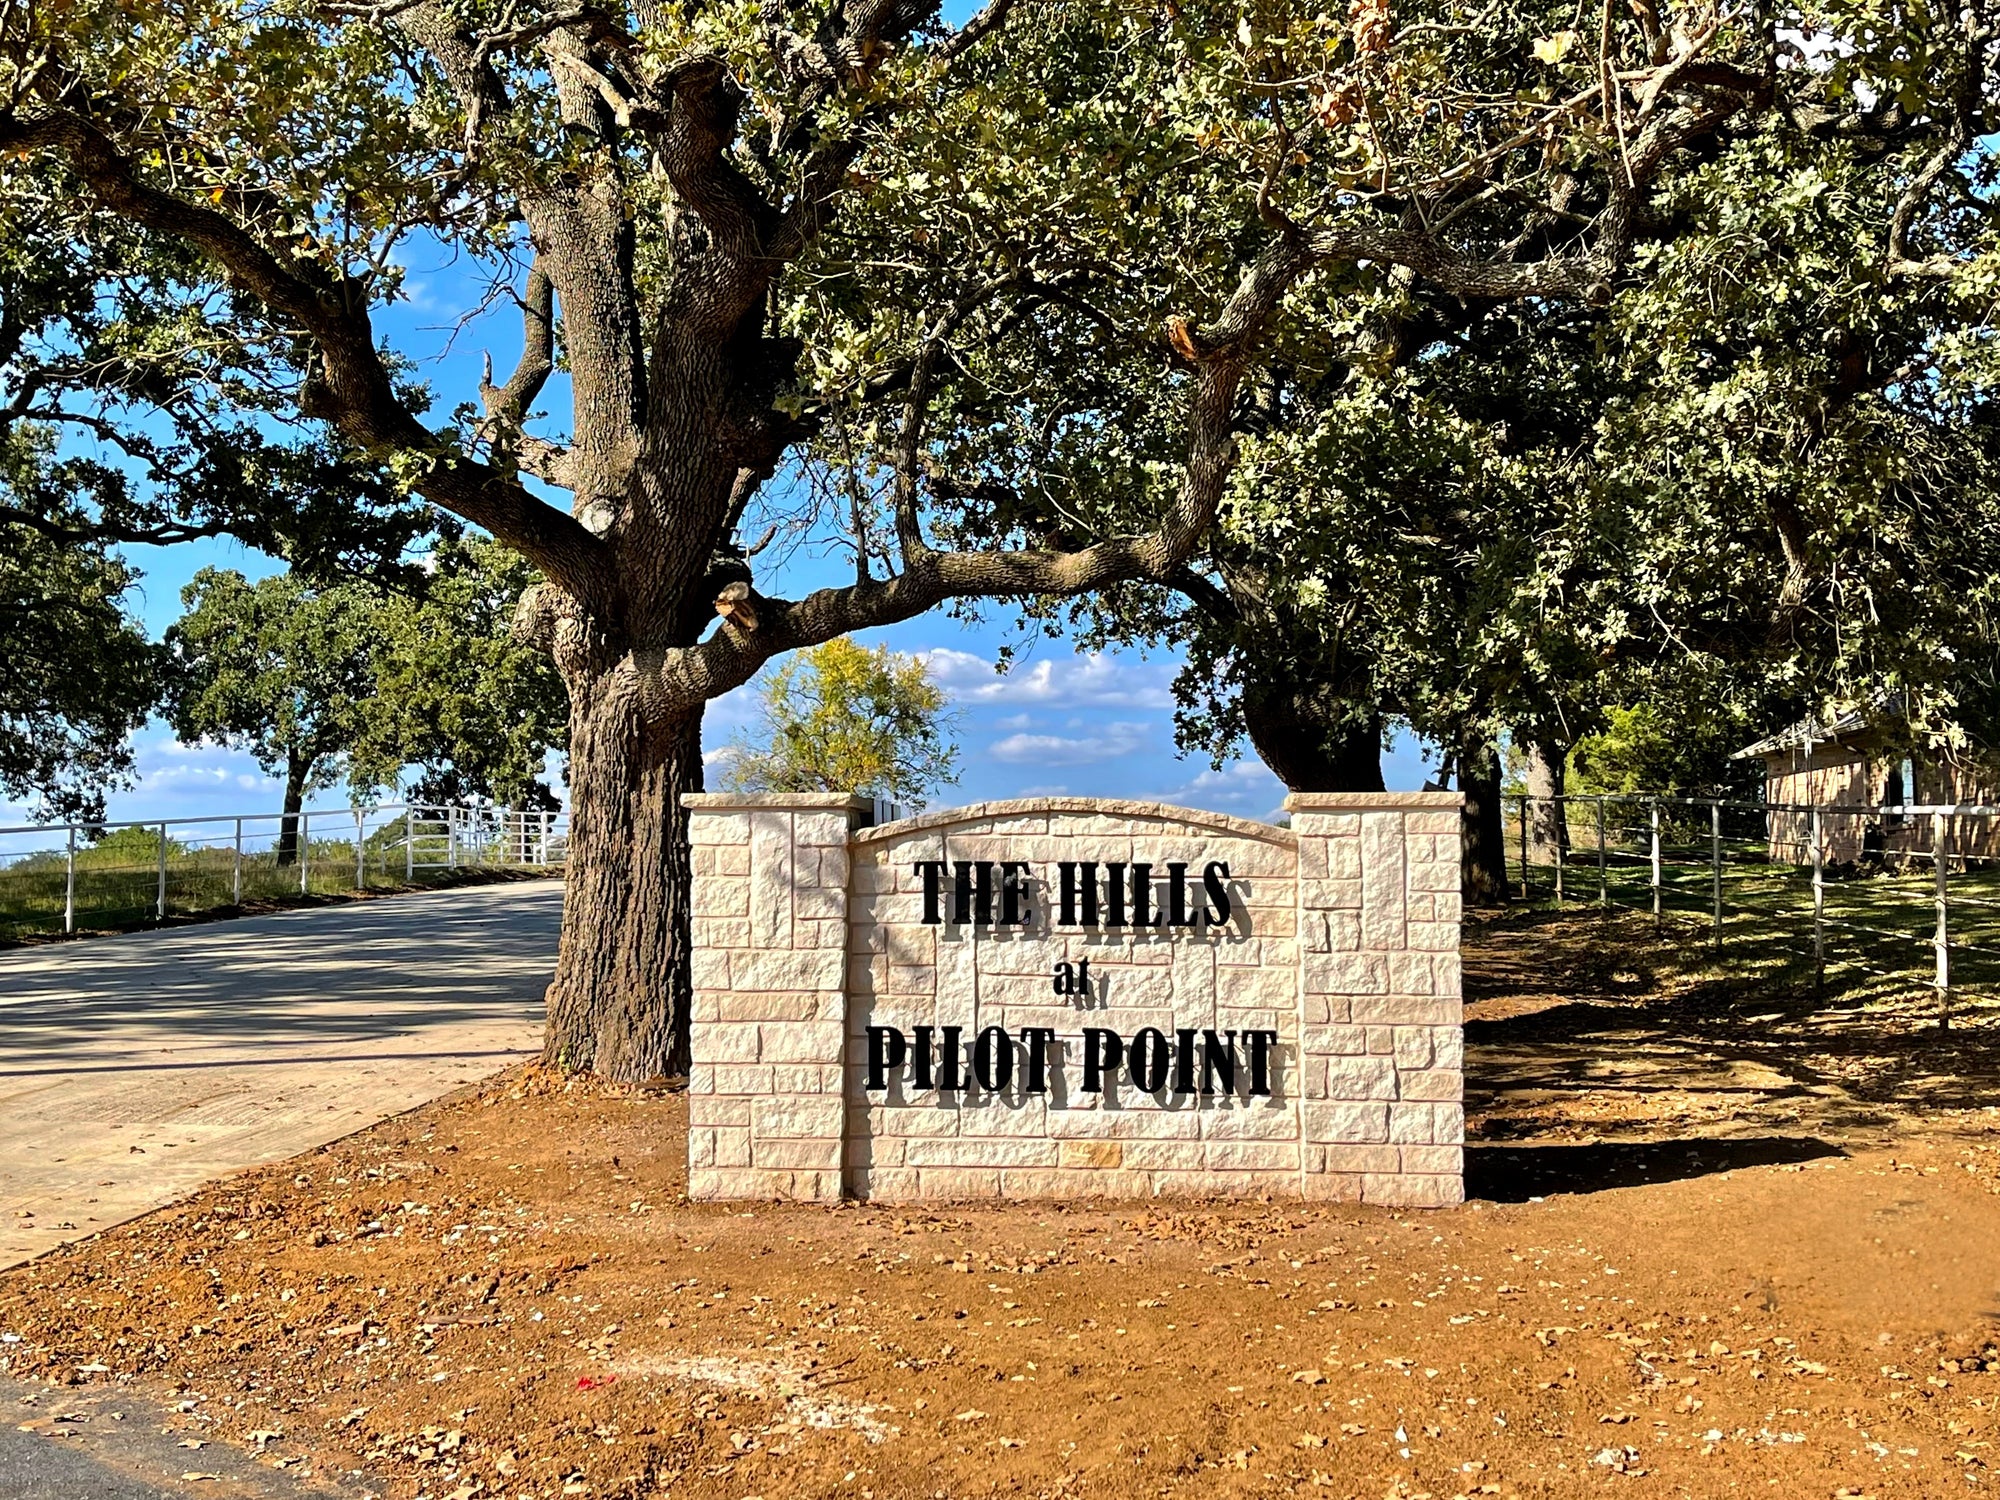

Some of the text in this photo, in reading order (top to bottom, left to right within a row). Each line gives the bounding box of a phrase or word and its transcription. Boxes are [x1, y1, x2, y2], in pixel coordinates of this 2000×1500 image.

[913, 860, 1231, 928] THE HILLS
[1052, 955, 1091, 996] at
[865, 1025, 1279, 1097] PILOT POINT
